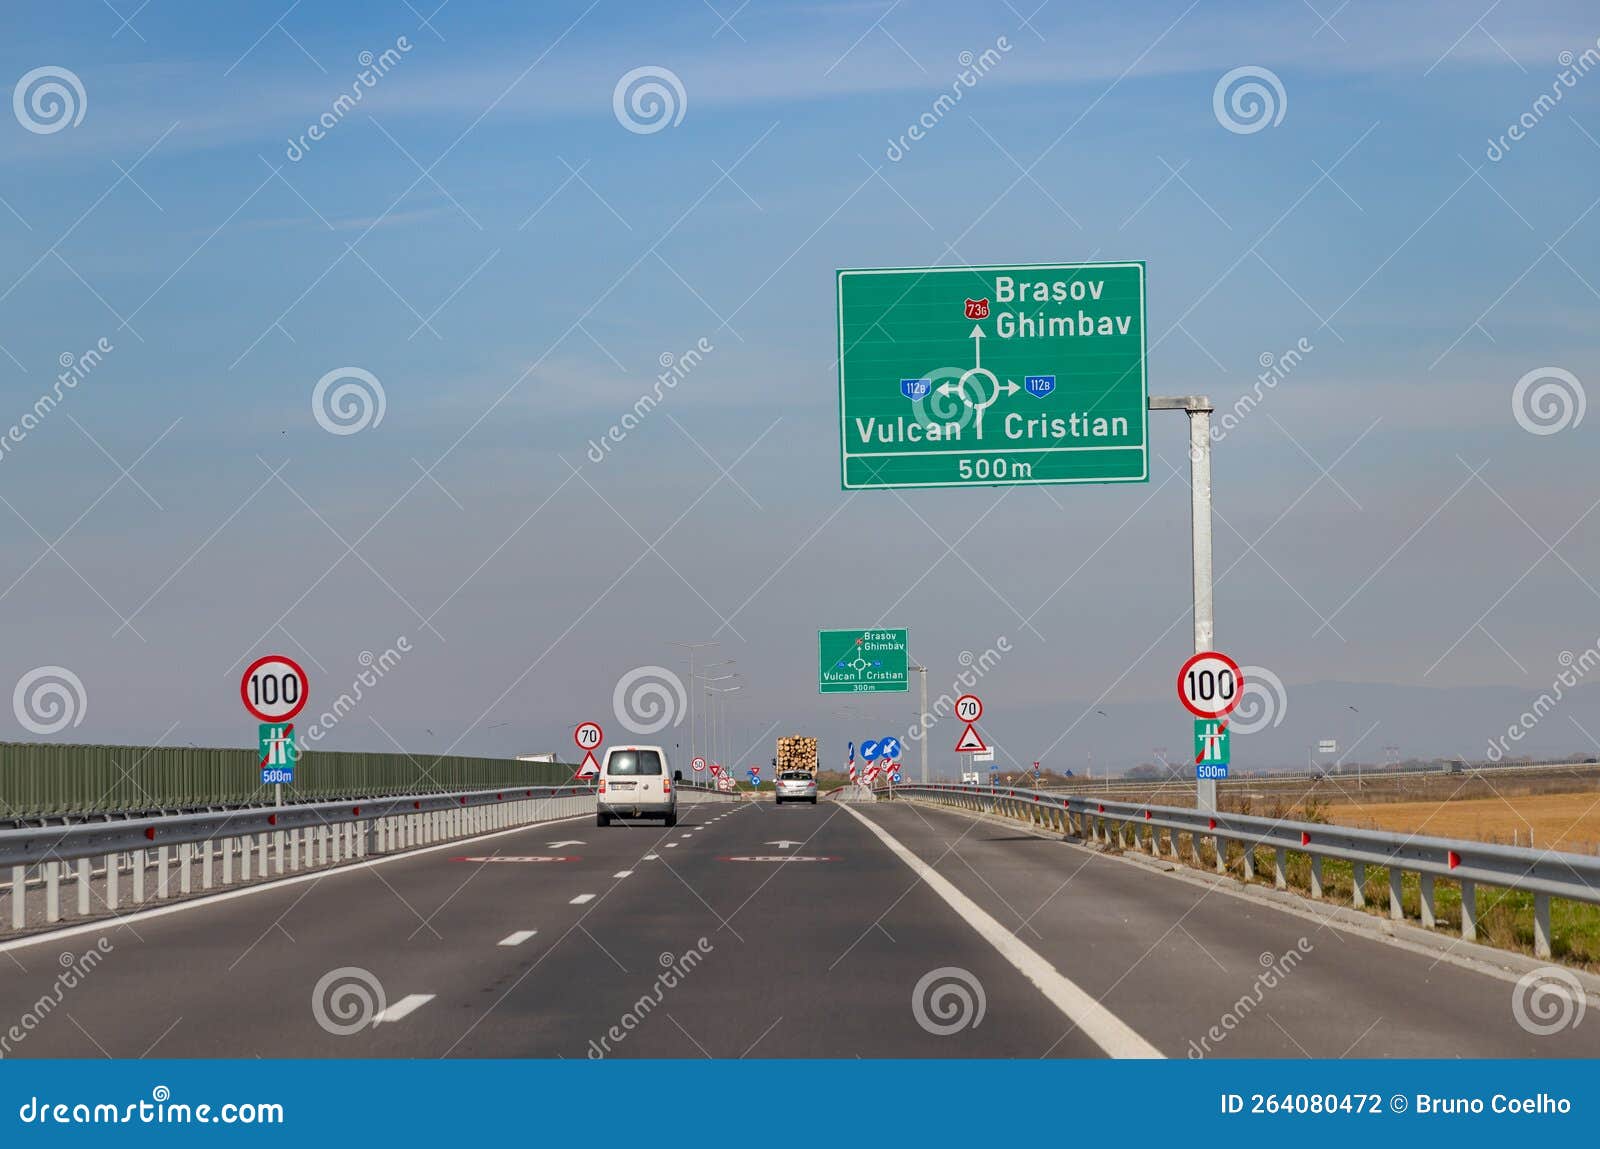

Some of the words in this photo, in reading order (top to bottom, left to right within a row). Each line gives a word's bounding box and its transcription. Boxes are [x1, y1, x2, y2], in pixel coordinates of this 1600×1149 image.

[996, 276, 1105, 304] Brașov
[967, 303, 987, 317] 73G
[996, 309, 1132, 339] Ghimbav
[1031, 379, 1051, 391] 112B
[856, 416, 962, 443] Vulcan
[1004, 411, 1129, 440] Cristian
[864, 642, 904, 651] Ghimbav
[823, 672, 855, 681] Vulcan
[866, 671, 904, 681] Cristian
[251, 673, 298, 705] 100
[1188, 669, 1234, 701] 100
[960, 702, 977, 716] 70
[581, 729, 597, 743] 70
[263, 770, 292, 782] 500m
[1199, 766, 1227, 778] 500m
